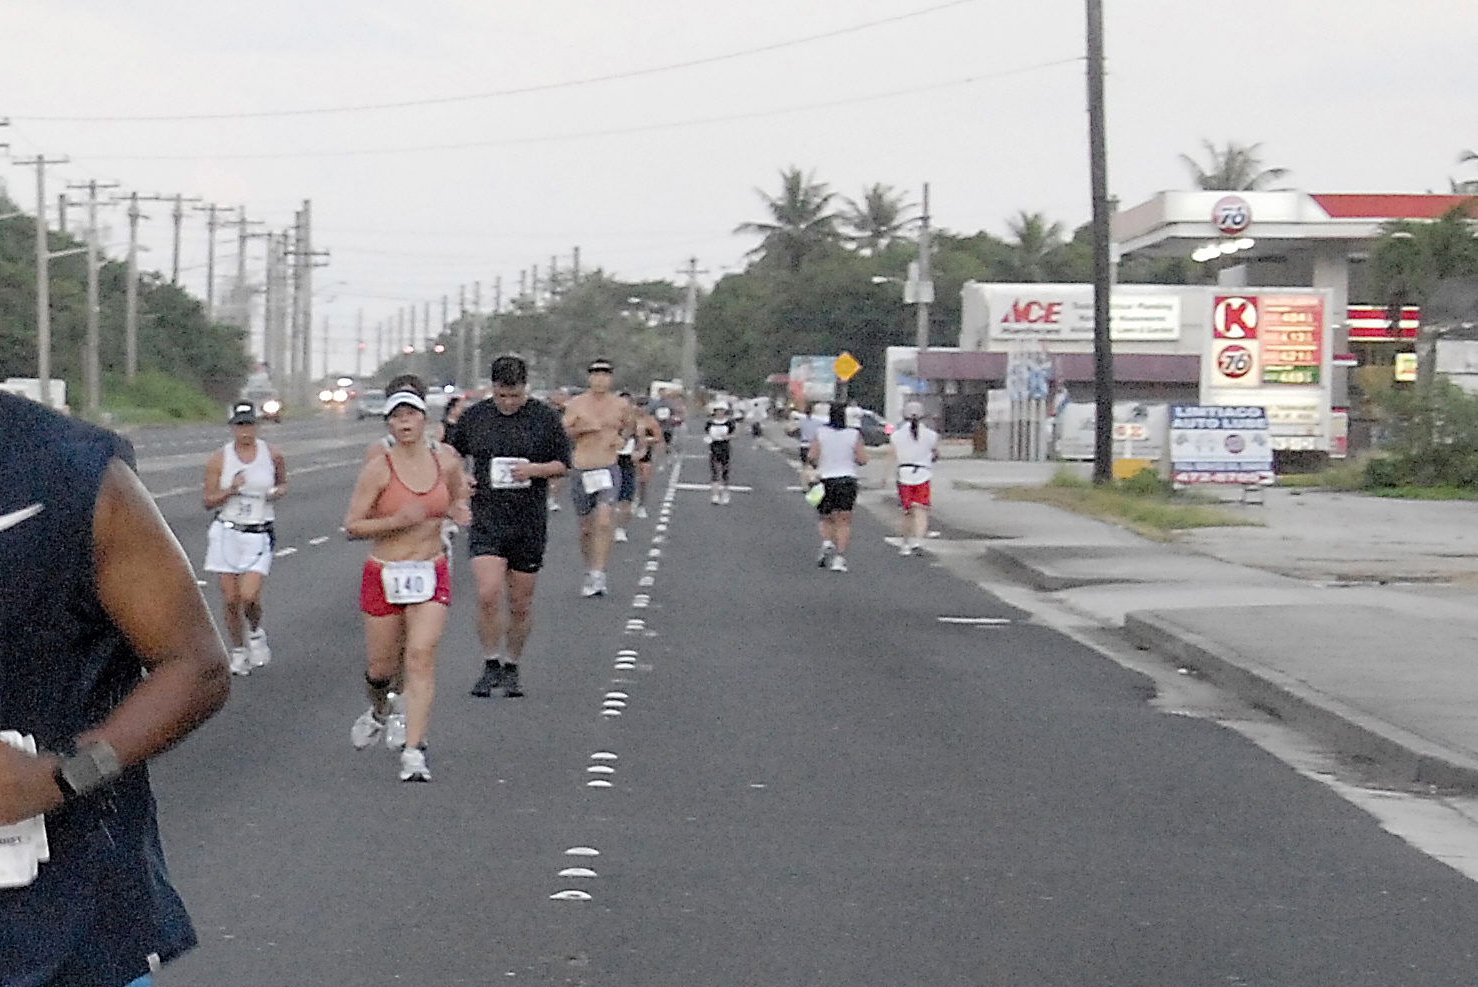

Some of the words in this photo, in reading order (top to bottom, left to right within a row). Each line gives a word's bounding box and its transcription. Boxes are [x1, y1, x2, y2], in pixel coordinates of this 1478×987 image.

[1221, 206, 1245, 226] 76
[1000, 299, 1063, 324] ACE
[1223, 302, 1256, 336] K
[1223, 354, 1248, 371] 76
[1173, 418, 1221, 429] AUTO
[1223, 418, 1268, 429] LUBE
[394, 576, 425, 594] 140
